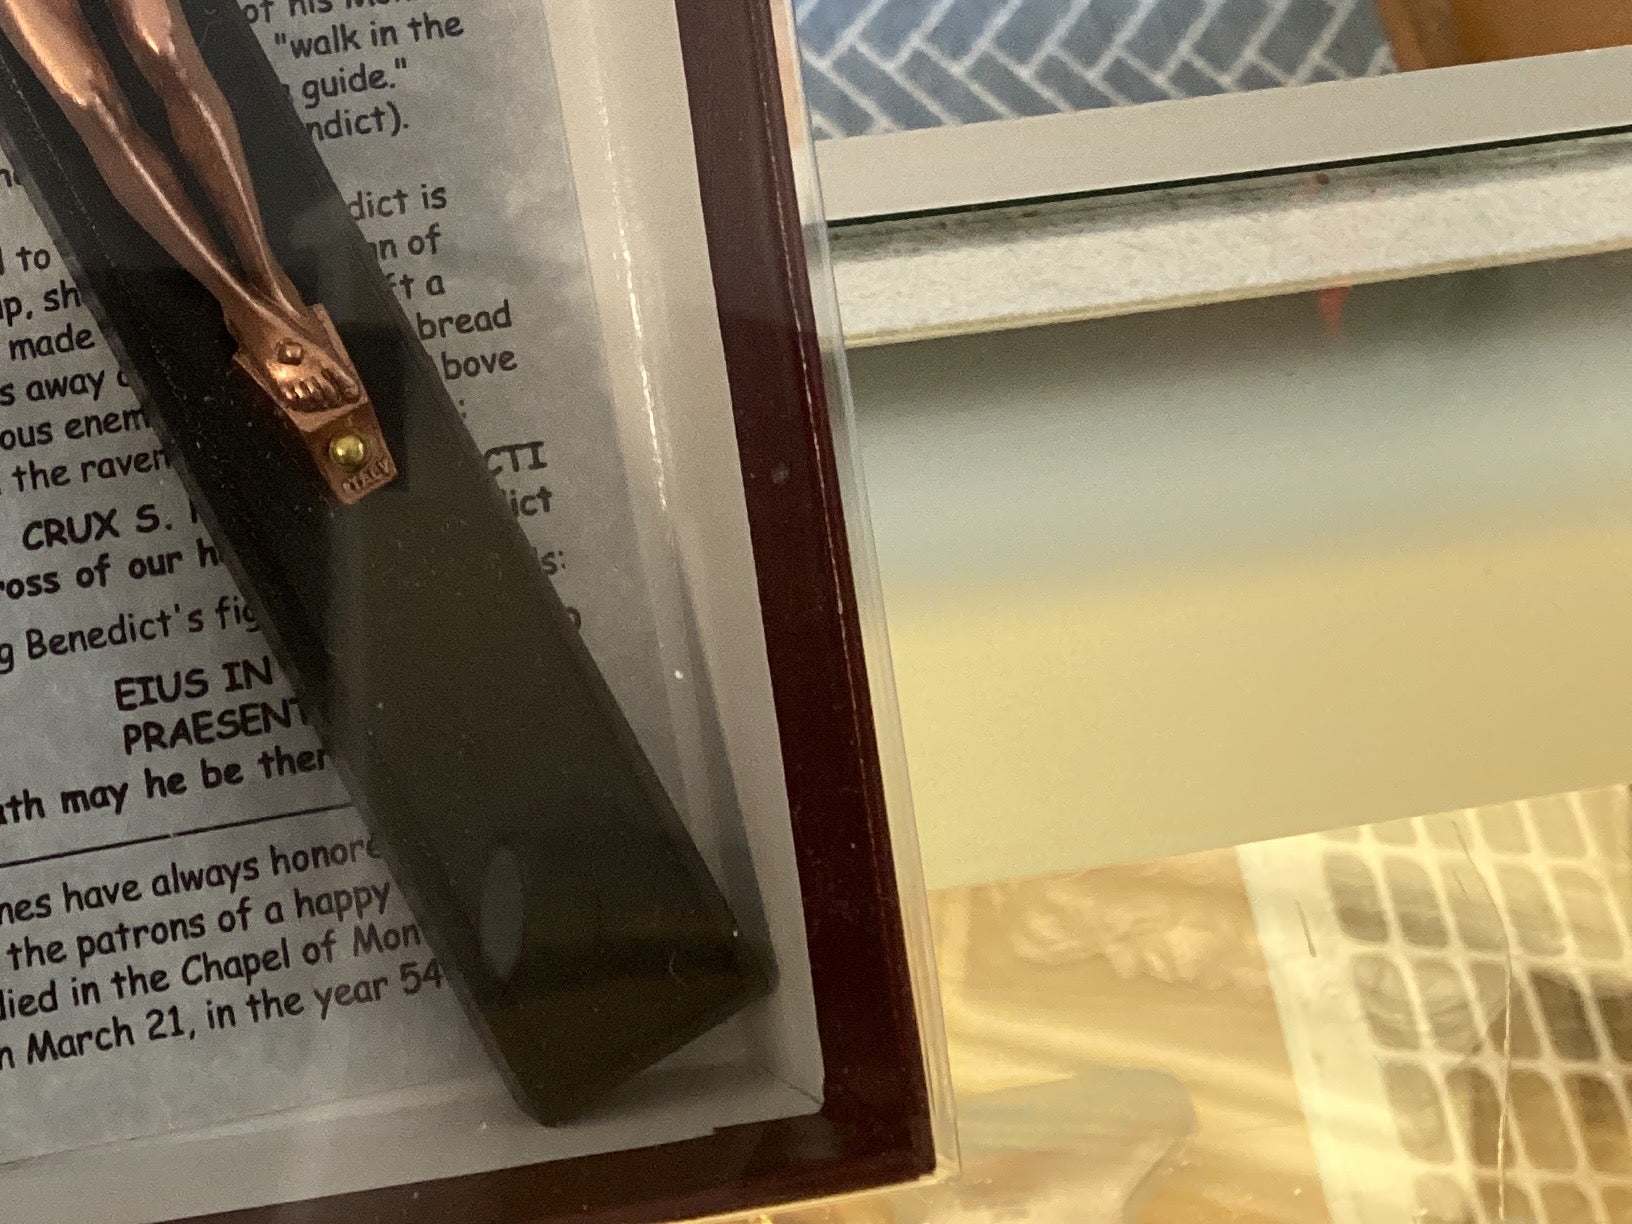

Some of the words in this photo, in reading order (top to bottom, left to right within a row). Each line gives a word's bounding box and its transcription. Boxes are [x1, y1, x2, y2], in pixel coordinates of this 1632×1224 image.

[275, 24, 362, 59] "walk
[371, 21, 398, 47] in
[408, 12, 465, 42] the
[302, 57, 407, 108] guide."
[421, 184, 447, 210] is
[16, 246, 50, 272] to
[408, 223, 441, 255] of
[425, 273, 446, 297] a
[9, 323, 95, 361] made
[417, 299, 512, 338] bread
[25, 369, 106, 402] away
[12, 460, 71, 492] the
[80, 449, 171, 484] raven
[22, 508, 120, 551] CRUX
[136, 504, 172, 533] S.
[76, 552, 111, 588] of
[128, 551, 182, 579] our
[26, 604, 203, 660] Benedict's
[114, 668, 208, 711] EIUS
[222, 657, 272, 692] IN
[60, 782, 129, 815] may
[144, 767, 187, 799] he
[201, 758, 243, 789] be
[62, 879, 143, 914] have
[151, 857, 260, 897] always
[6, 935, 68, 972] the
[76, 913, 207, 969] patrons
[217, 896, 252, 933] of
[265, 901, 284, 924] a
[294, 881, 390, 923] happy
[70, 978, 101, 1008] in
[110, 965, 170, 999] the
[181, 937, 292, 987] Chapel
[303, 928, 337, 965] of
[27, 1015, 135, 1065] March
[146, 1005, 195, 1041] 21,
[206, 999, 236, 1029] in
[245, 987, 305, 1024] the
[314, 977, 388, 1020] year
